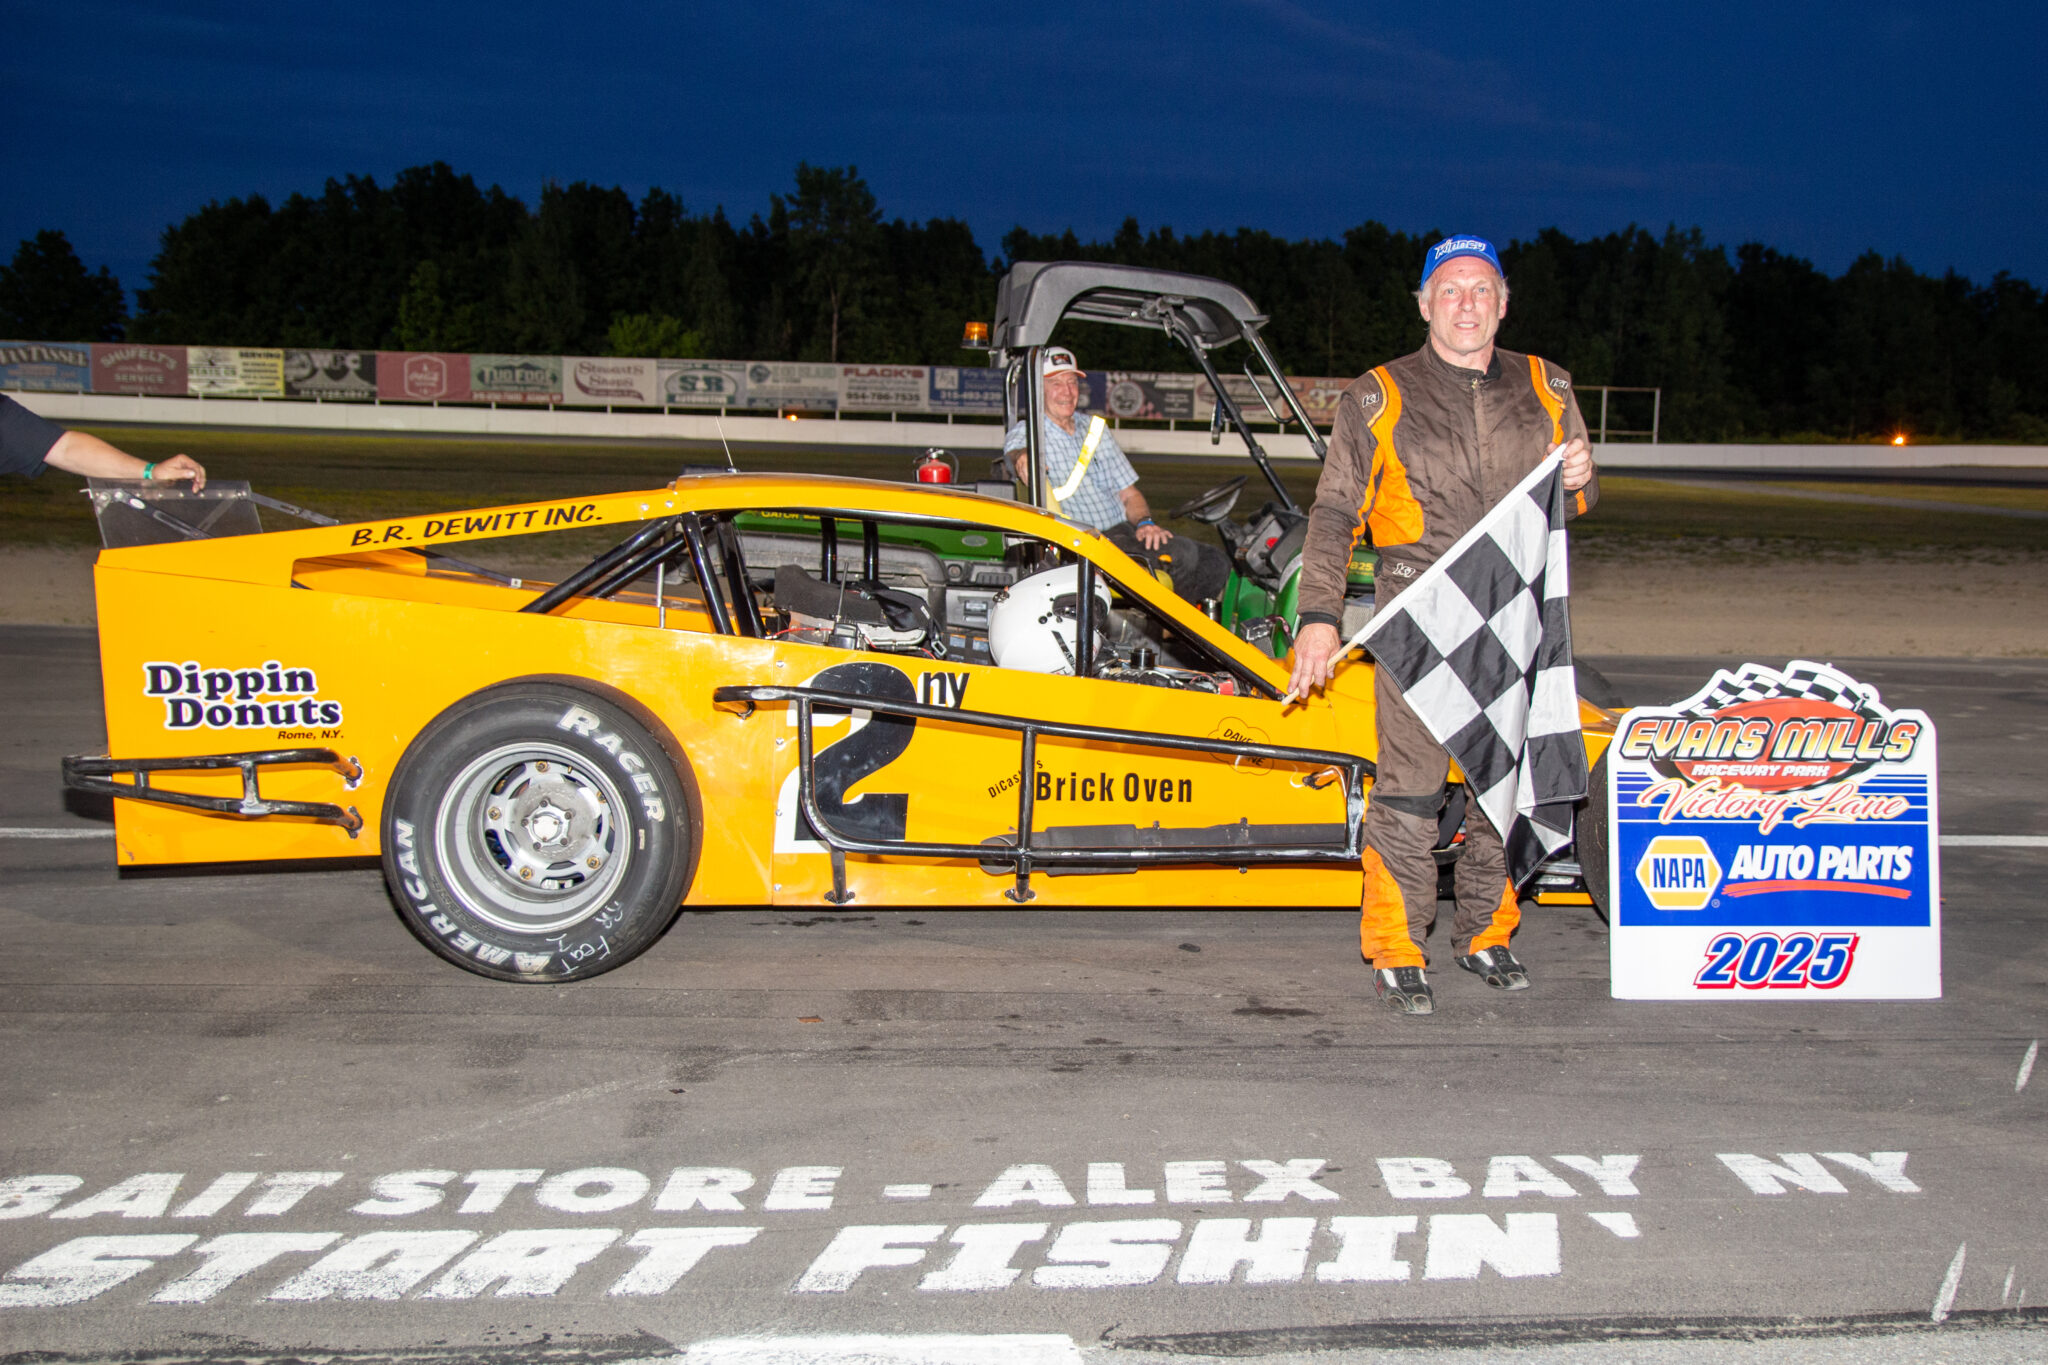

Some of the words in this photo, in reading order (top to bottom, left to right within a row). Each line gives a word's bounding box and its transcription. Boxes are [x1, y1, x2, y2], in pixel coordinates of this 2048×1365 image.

[843, 367, 925, 379] FLACK'S
[350, 525, 412, 547] B.R.
[423, 510, 539, 538] DEWITT
[543, 504, 604, 527] INC.
[145, 661, 316, 702] Dippin
[166, 697, 341, 729] Donuts
[277, 730, 317, 742] Rome,
[787, 661, 918, 843] 2
[1620, 716, 1775, 762] EVANS
[1766, 717, 1924, 763] MILLS
[557, 704, 666, 824] RACER
[1036, 771, 1115, 802] Brick
[1123, 772, 1193, 803] Oven
[1691, 763, 1779, 777] RACEWAY
[1781, 764, 1831, 777] PARK
[1637, 775, 1793, 836] Victory
[1793, 780, 1911, 829] Lane
[1652, 857, 1707, 889] NAPA
[1727, 844, 1815, 881] AUTO
[1816, 844, 1913, 881] PARTS
[394, 818, 555, 975] AMERICAN
[1693, 931, 1861, 990] 2025
[0, 1172, 345, 1220] BAIT
[348, 1166, 845, 1215] STORE
[971, 1158, 1341, 1207] ALEX
[1375, 1154, 1643, 1199] BAY
[1715, 1151, 1922, 1195] NY
[0, 1225, 766, 1307] START
